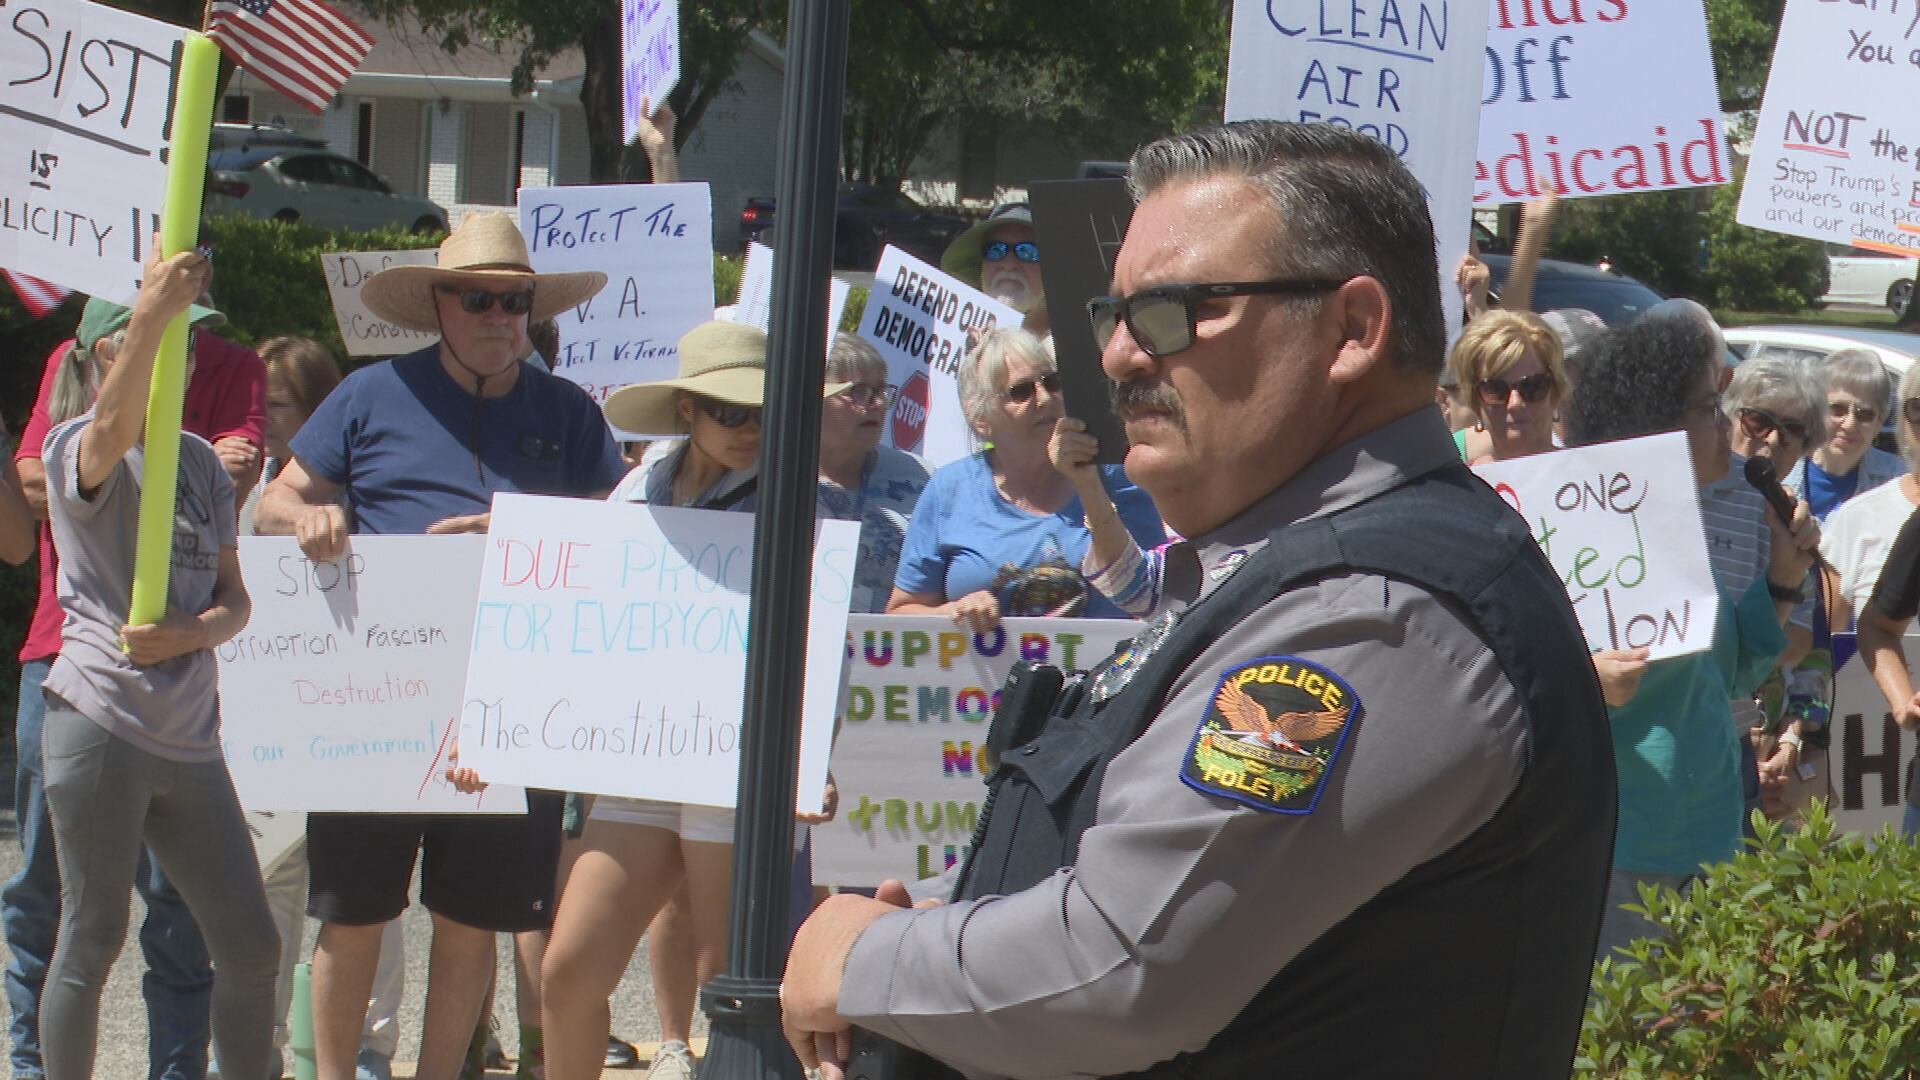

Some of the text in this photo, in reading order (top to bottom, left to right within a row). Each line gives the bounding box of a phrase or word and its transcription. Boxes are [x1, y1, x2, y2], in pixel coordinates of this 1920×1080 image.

[1266, 0, 1448, 51] CLEAN
[1846, 29, 1896, 64] You
[1298, 59, 1401, 112] AIR
[1473, 118, 1728, 202] edicaid
[1783, 110, 1867, 148] NOT
[1870, 128, 1909, 162] the
[1774, 158, 1818, 185] Stop
[1824, 165, 1901, 197] Trump's
[0, 197, 113, 257] LICITY
[1765, 207, 1803, 225] and
[1813, 217, 1844, 232] our
[1849, 200, 1886, 220] and
[890, 265, 998, 336] DEFEND OUR
[873, 305, 966, 380] DEMOCRA
[894, 396, 927, 430] STOP
[276, 553, 366, 596] STOP
[621, 540, 850, 605] PROCS
[473, 600, 748, 656] FOR EVERYON
[846, 627, 1084, 671] UPPORT
[291, 671, 430, 705] Destruction
[1234, 664, 1344, 713] POLICE
[309, 719, 438, 757] Government
[541, 698, 742, 758] Constitutio
[1202, 763, 1292, 803] FOLEY
